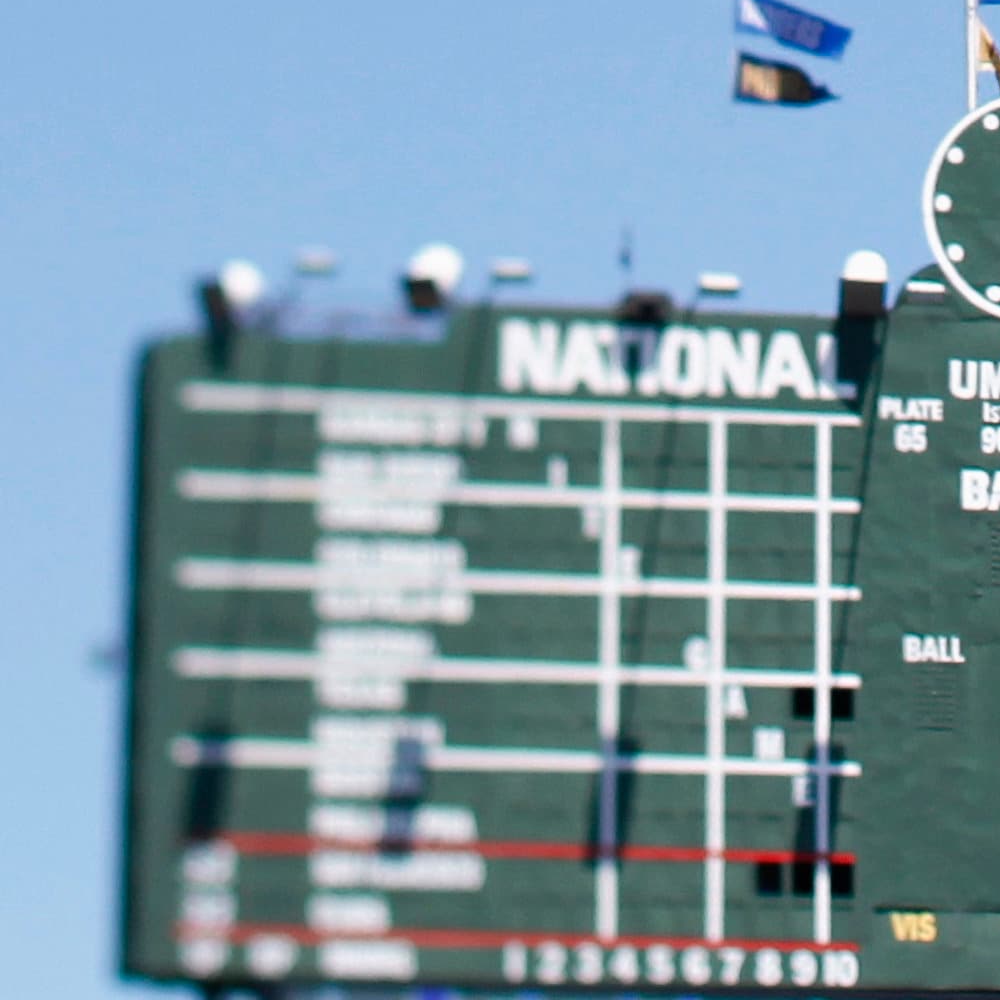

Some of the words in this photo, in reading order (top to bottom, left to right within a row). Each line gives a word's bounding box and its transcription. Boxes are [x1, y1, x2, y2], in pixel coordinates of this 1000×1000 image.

[500, 318, 857, 400] NATIONAL
[877, 396, 944, 421] PLATE
[903, 637, 965, 663] BALL
[719, 948, 744, 985] 7
[755, 948, 782, 986] 8
[792, 949, 817, 986] 9
